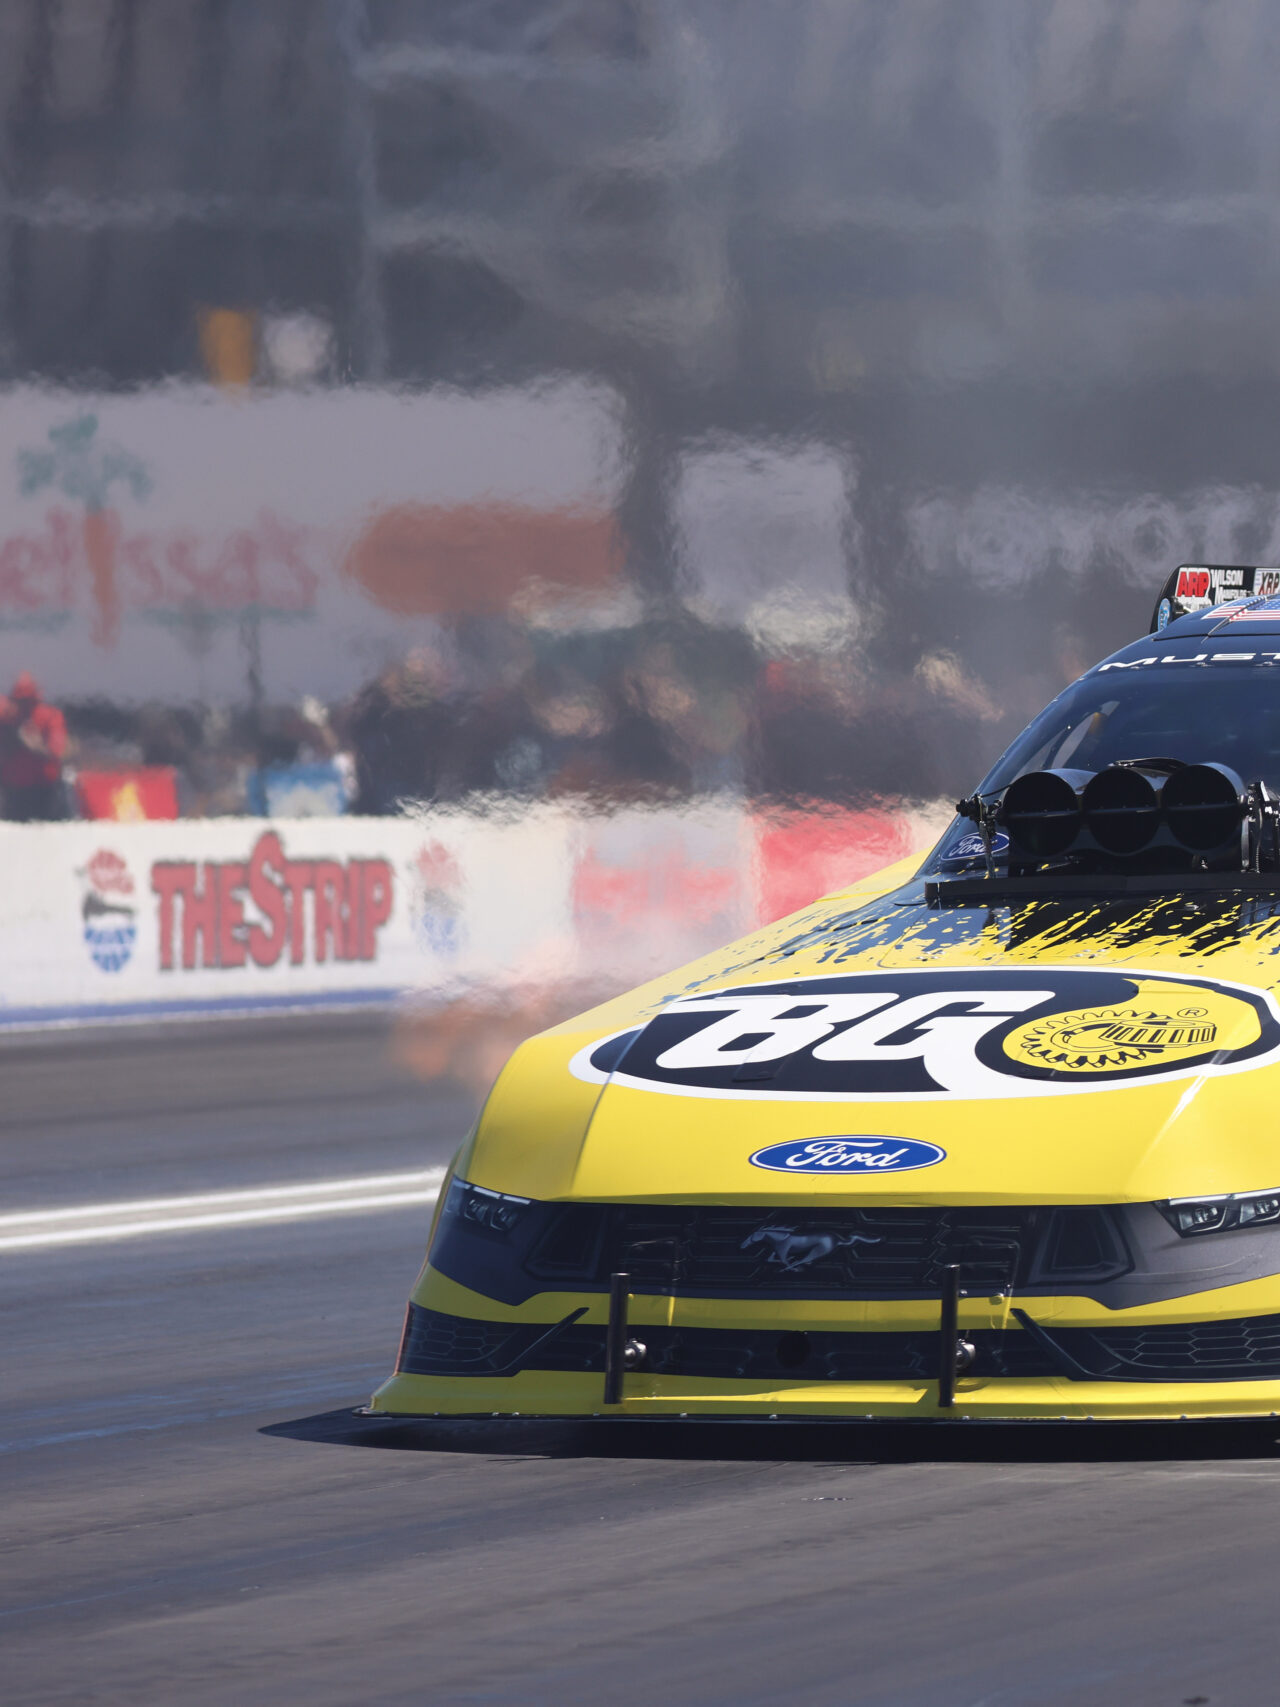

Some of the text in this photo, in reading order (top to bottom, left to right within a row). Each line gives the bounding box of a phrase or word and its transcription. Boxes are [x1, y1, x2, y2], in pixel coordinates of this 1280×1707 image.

[1176, 571, 1211, 598] ARP
[1211, 569, 1244, 586] WILSON
[655, 989, 1057, 1070] BG
[785, 1140, 905, 1169] Ford
